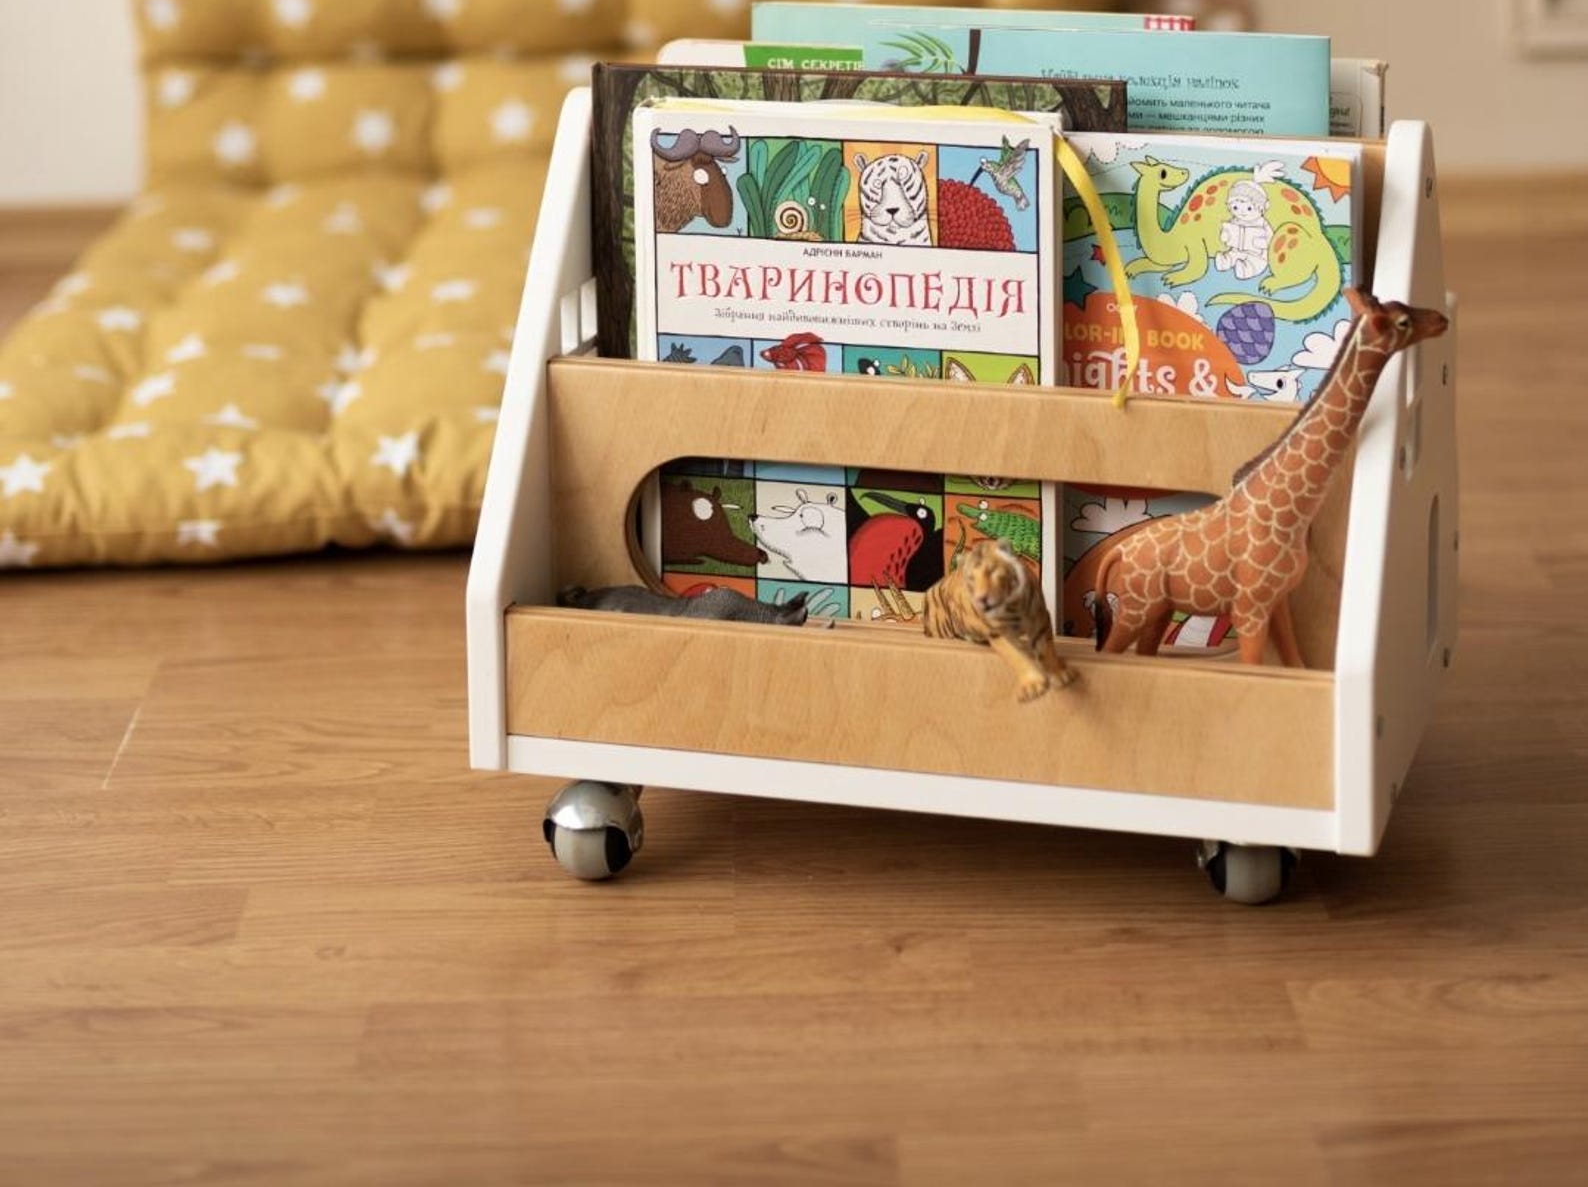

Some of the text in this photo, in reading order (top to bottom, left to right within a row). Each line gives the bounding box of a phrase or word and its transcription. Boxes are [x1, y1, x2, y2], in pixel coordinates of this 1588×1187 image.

[1170, 99, 1233, 110] маленького
[1235, 101, 1271, 111] читача
[1158, 113, 1228, 124] мешканцями
[845, 249, 883, 260] БАРМАН
[670, 261, 1026, 319] ТВАРИНОПЕДІЯ
[1147, 330, 1205, 351] BOOK
[1188, 357, 1219, 398] &
